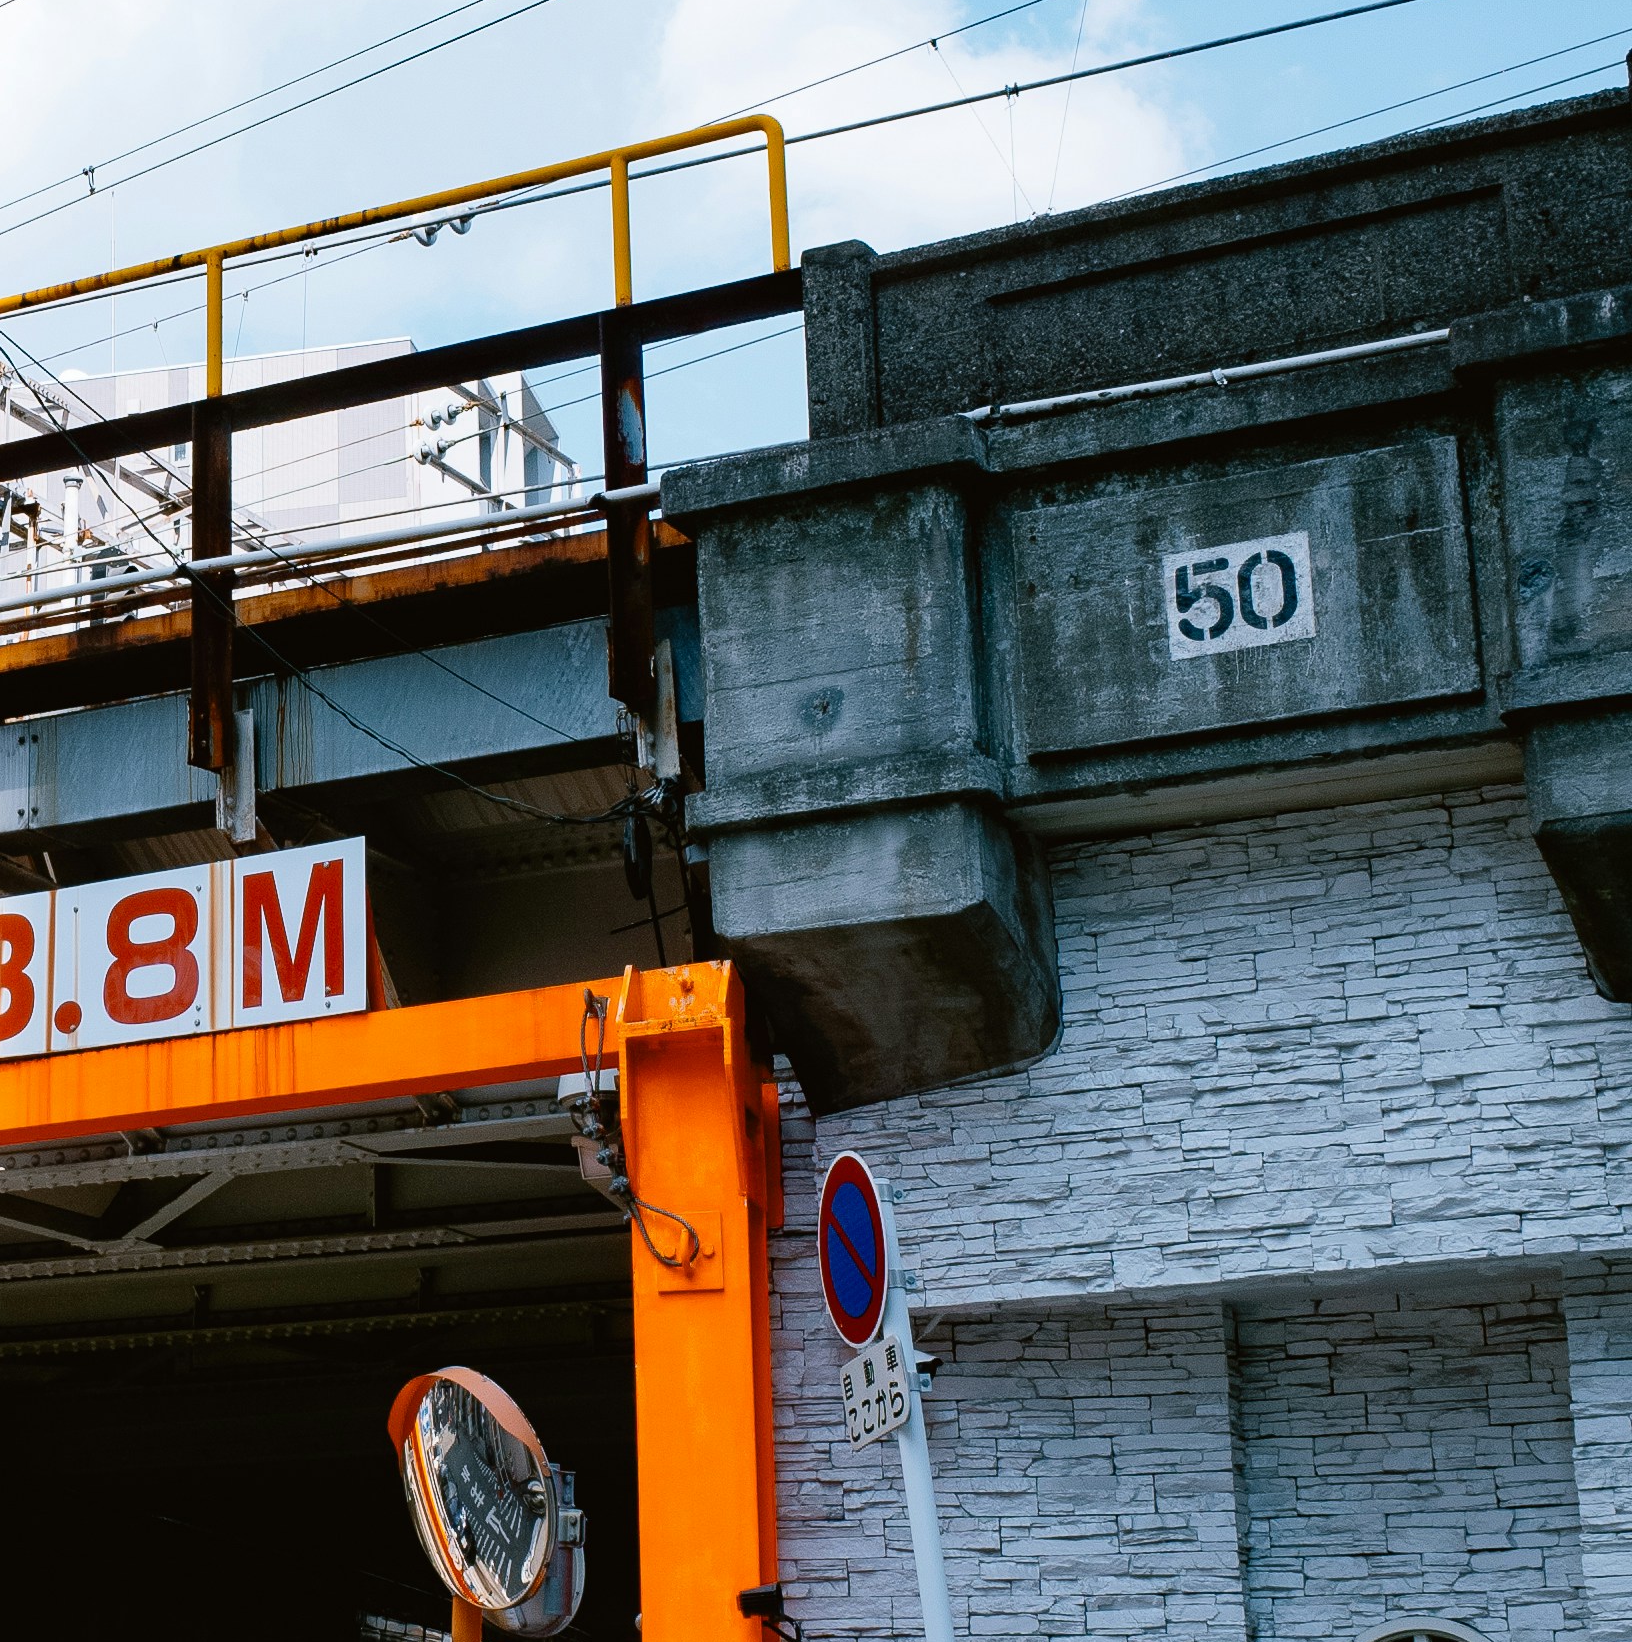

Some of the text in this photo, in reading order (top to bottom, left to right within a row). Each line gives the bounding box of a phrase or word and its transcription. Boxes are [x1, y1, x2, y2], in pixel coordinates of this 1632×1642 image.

[1175, 550, 1298, 641] 50
[843, 1344, 899, 1400] 自動車
[849, 1381, 905, 1443] ここから
